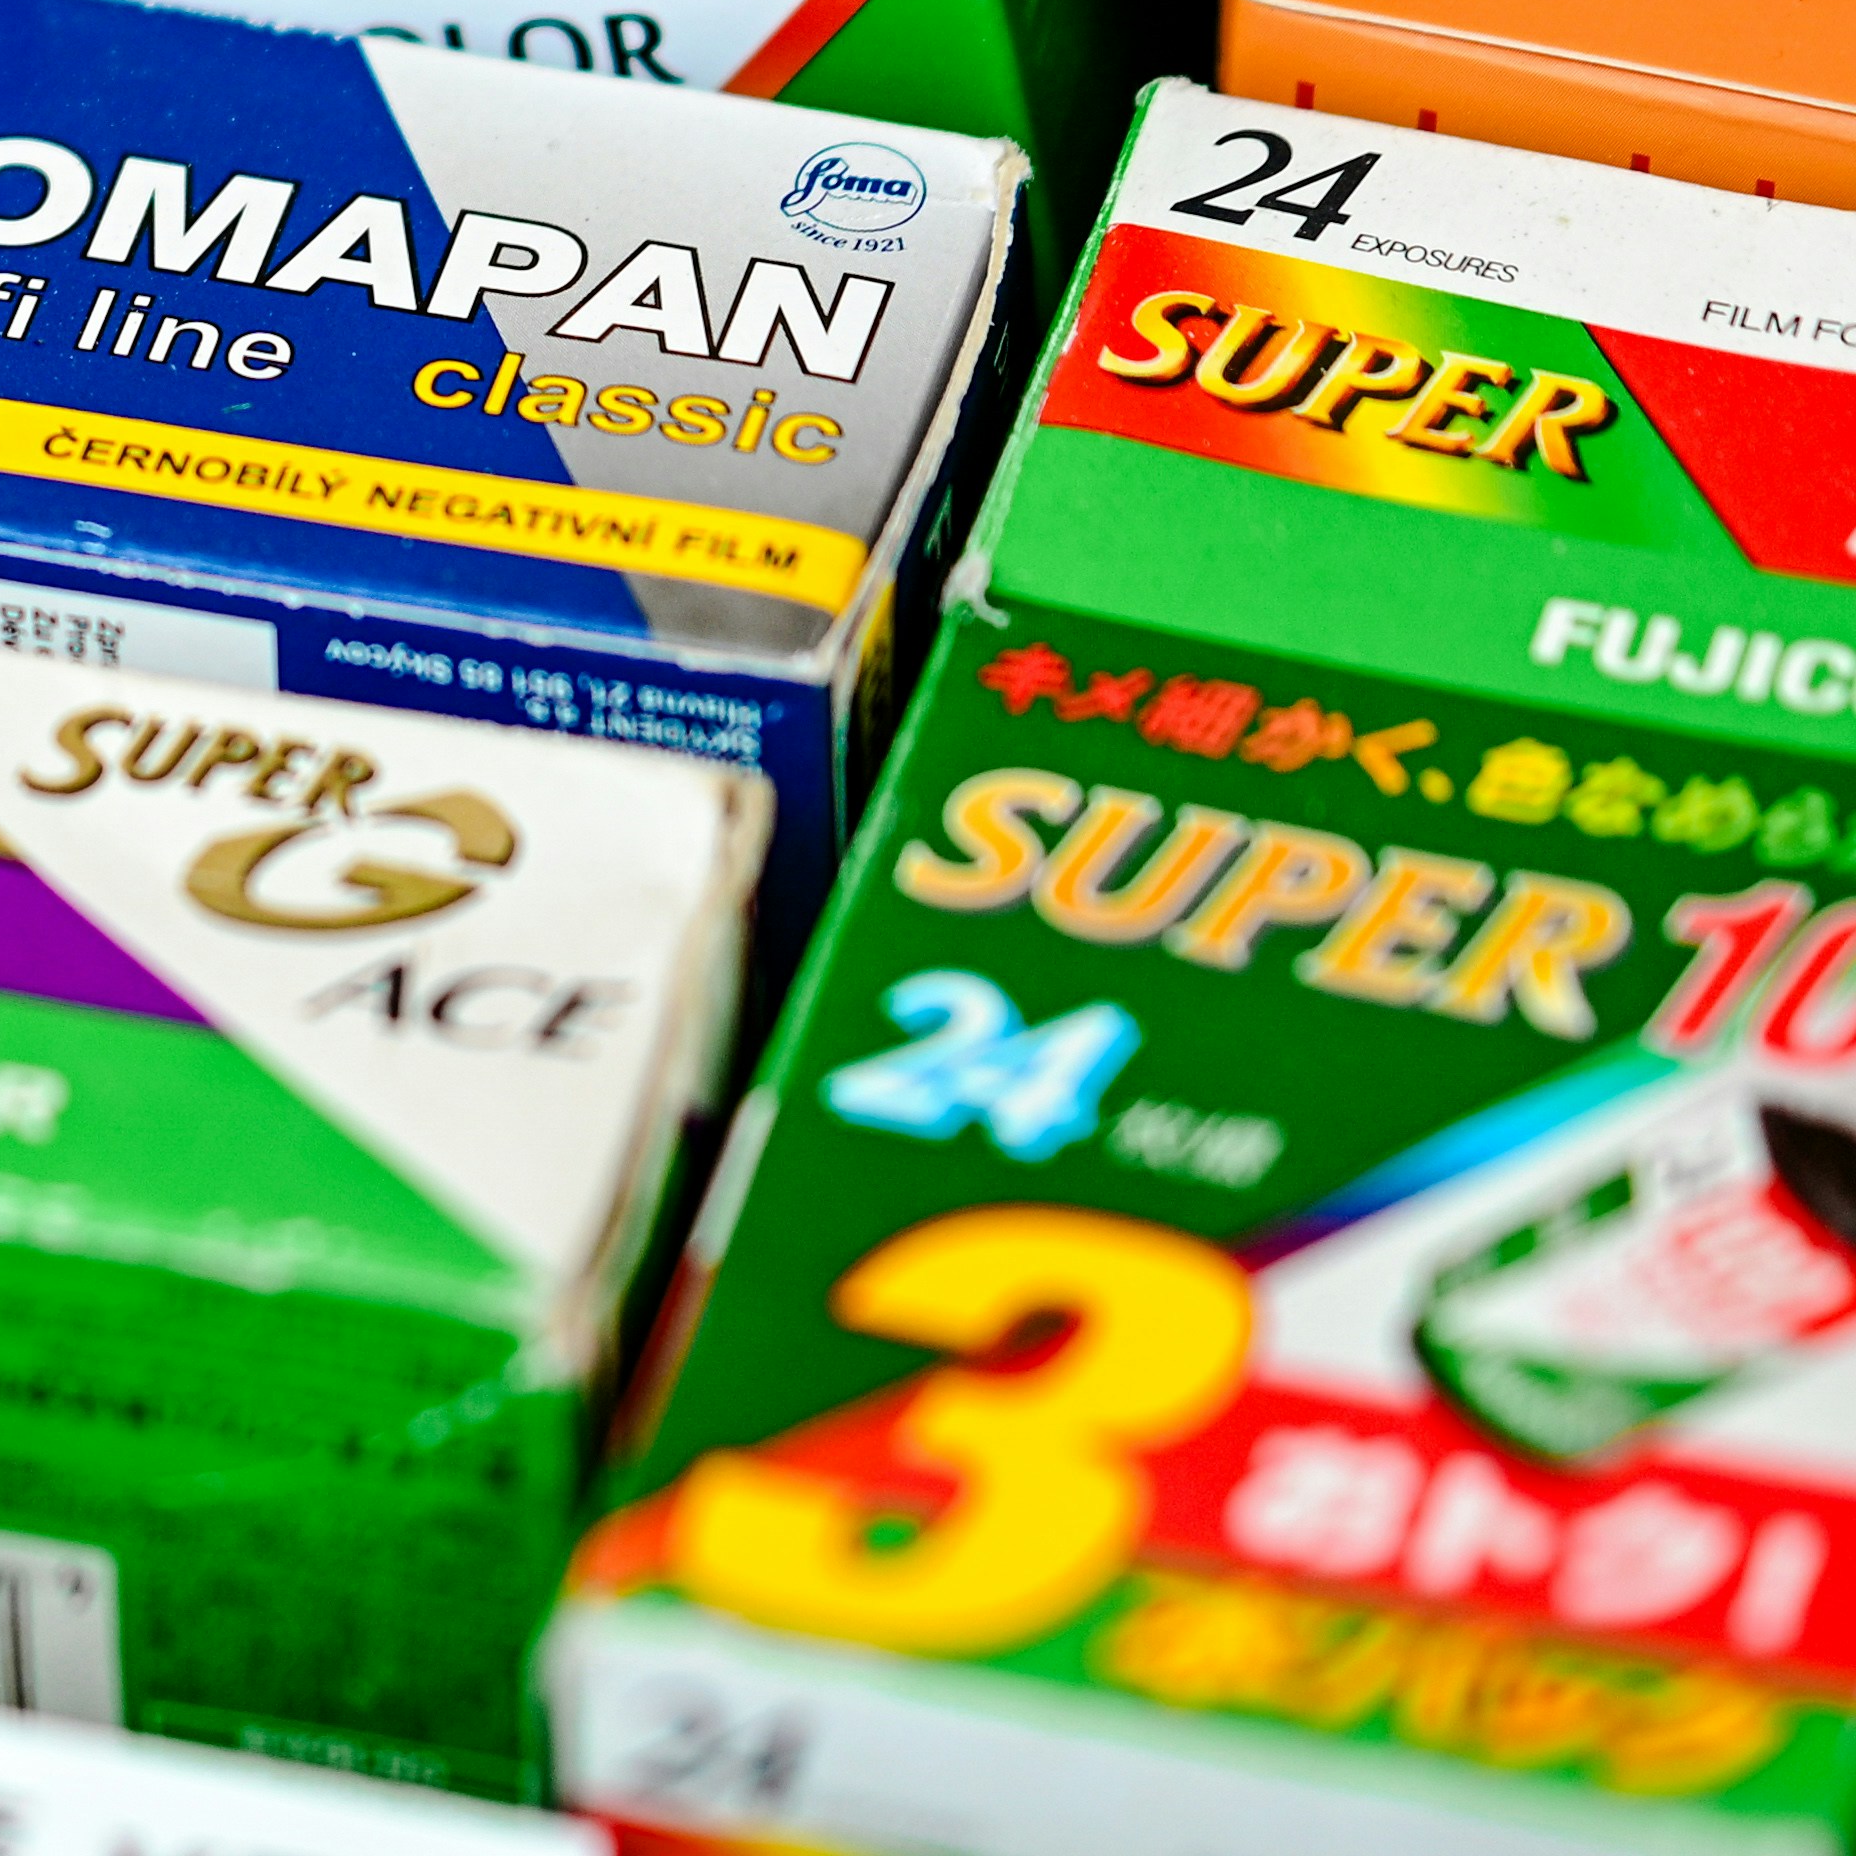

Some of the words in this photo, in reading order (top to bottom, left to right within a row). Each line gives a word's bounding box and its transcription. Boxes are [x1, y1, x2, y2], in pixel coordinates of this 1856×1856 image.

[790, 221, 848, 249] since
[851, 236, 908, 253] 1921
[1170, 128, 1383, 243] 24
[1350, 232, 1520, 285] EXPOSURES
[76, 286, 294, 382] line
[1096, 289, 1618, 482] SUPER
[1700, 299, 1803, 339] FILM
[412, 352, 845, 465] classic
[41, 422, 349, 503] ČERNOBÍLÝ
[365, 482, 658, 554] NEGATIVNÍ
[680, 529, 801, 576] FILM
[1530, 595, 1856, 717] FUJIC
[18, 704, 377, 823] SUPER
[183, 788, 520, 932] G
[894, 766, 1633, 1041] SUPER
[304, 954, 640, 1061] ACE
[820, 967, 1144, 1165] 24
[666, 1199, 1260, 1659] 3
